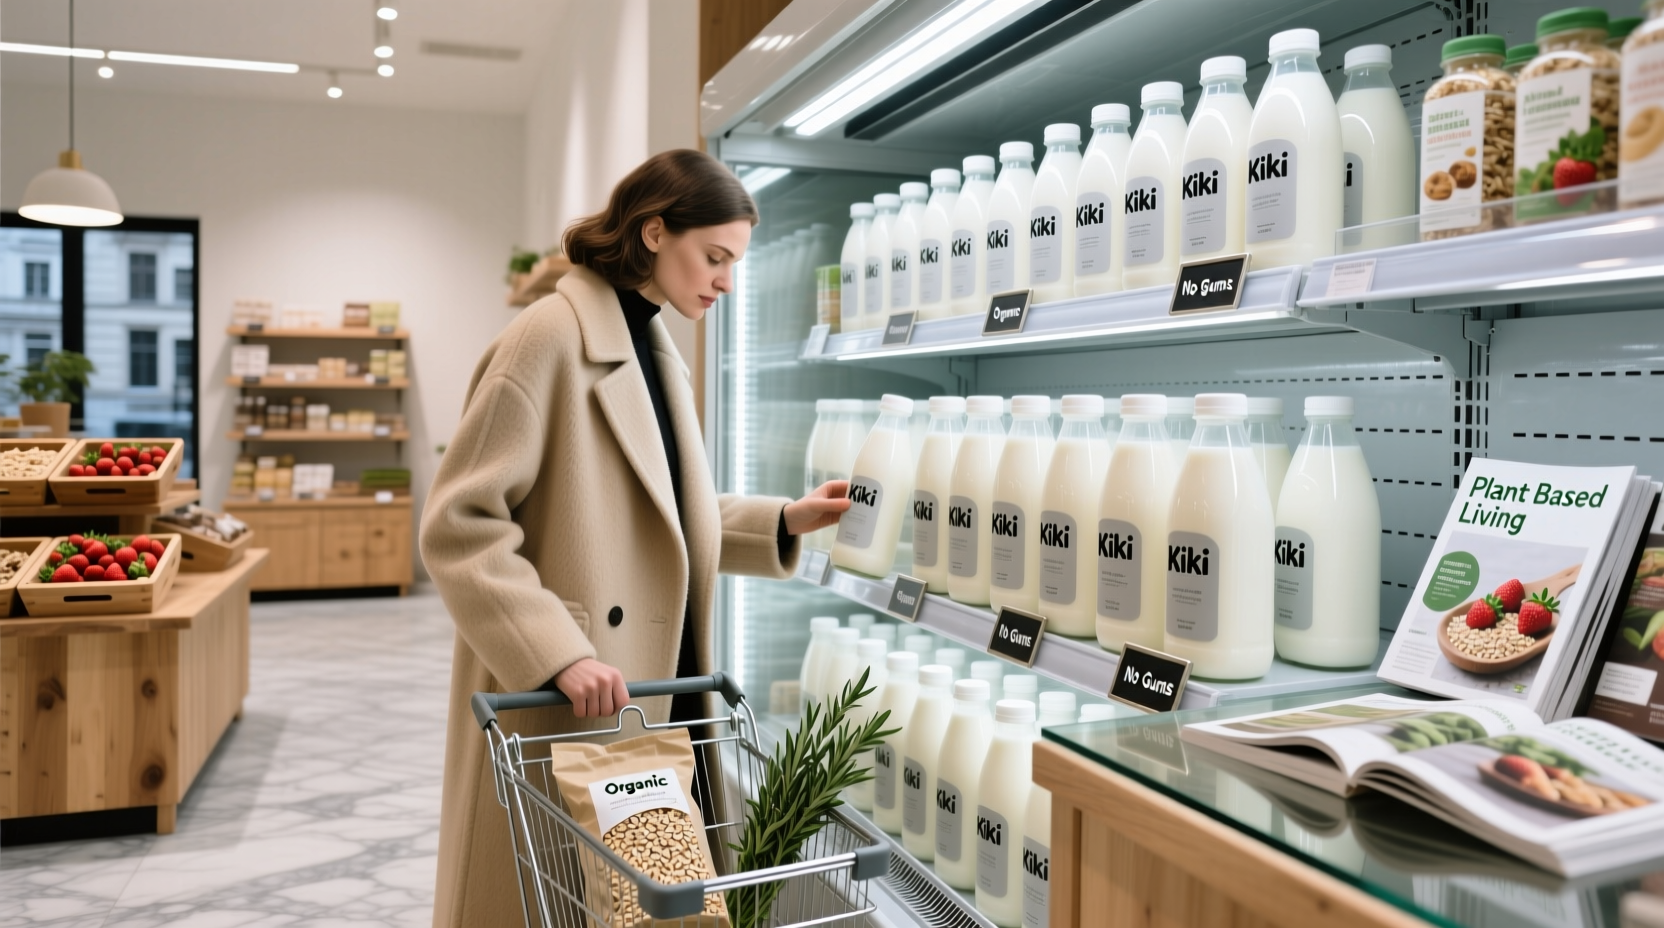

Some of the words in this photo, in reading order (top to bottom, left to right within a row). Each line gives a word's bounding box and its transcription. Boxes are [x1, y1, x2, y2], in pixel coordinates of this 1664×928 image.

[1248, 151, 1289, 184] Kiki
[1182, 170, 1219, 200] Kiki
[1125, 187, 1157, 214] Kiki
[1030, 216, 1056, 239] Kiki
[1076, 202, 1104, 228] Kiki
[1181, 279, 1198, 296] No
[848, 483, 878, 507] Kiki
[1469, 476, 1530, 503] Plant
[1533, 482, 1609, 508] Based
[991, 512, 1018, 537] Kiki
[1458, 502, 1527, 535] Living
[1040, 521, 1070, 548] Kiki
[1098, 532, 1134, 560] Kiki
[1168, 545, 1210, 576] Kiki
[1274, 539, 1305, 568] Kiki
[1124, 665, 1140, 685] No
[1142, 671, 1174, 697] Gums
[604, 774, 669, 795] Organic
[976, 815, 1002, 846] Kiki
[1022, 846, 1049, 881] Kiki
